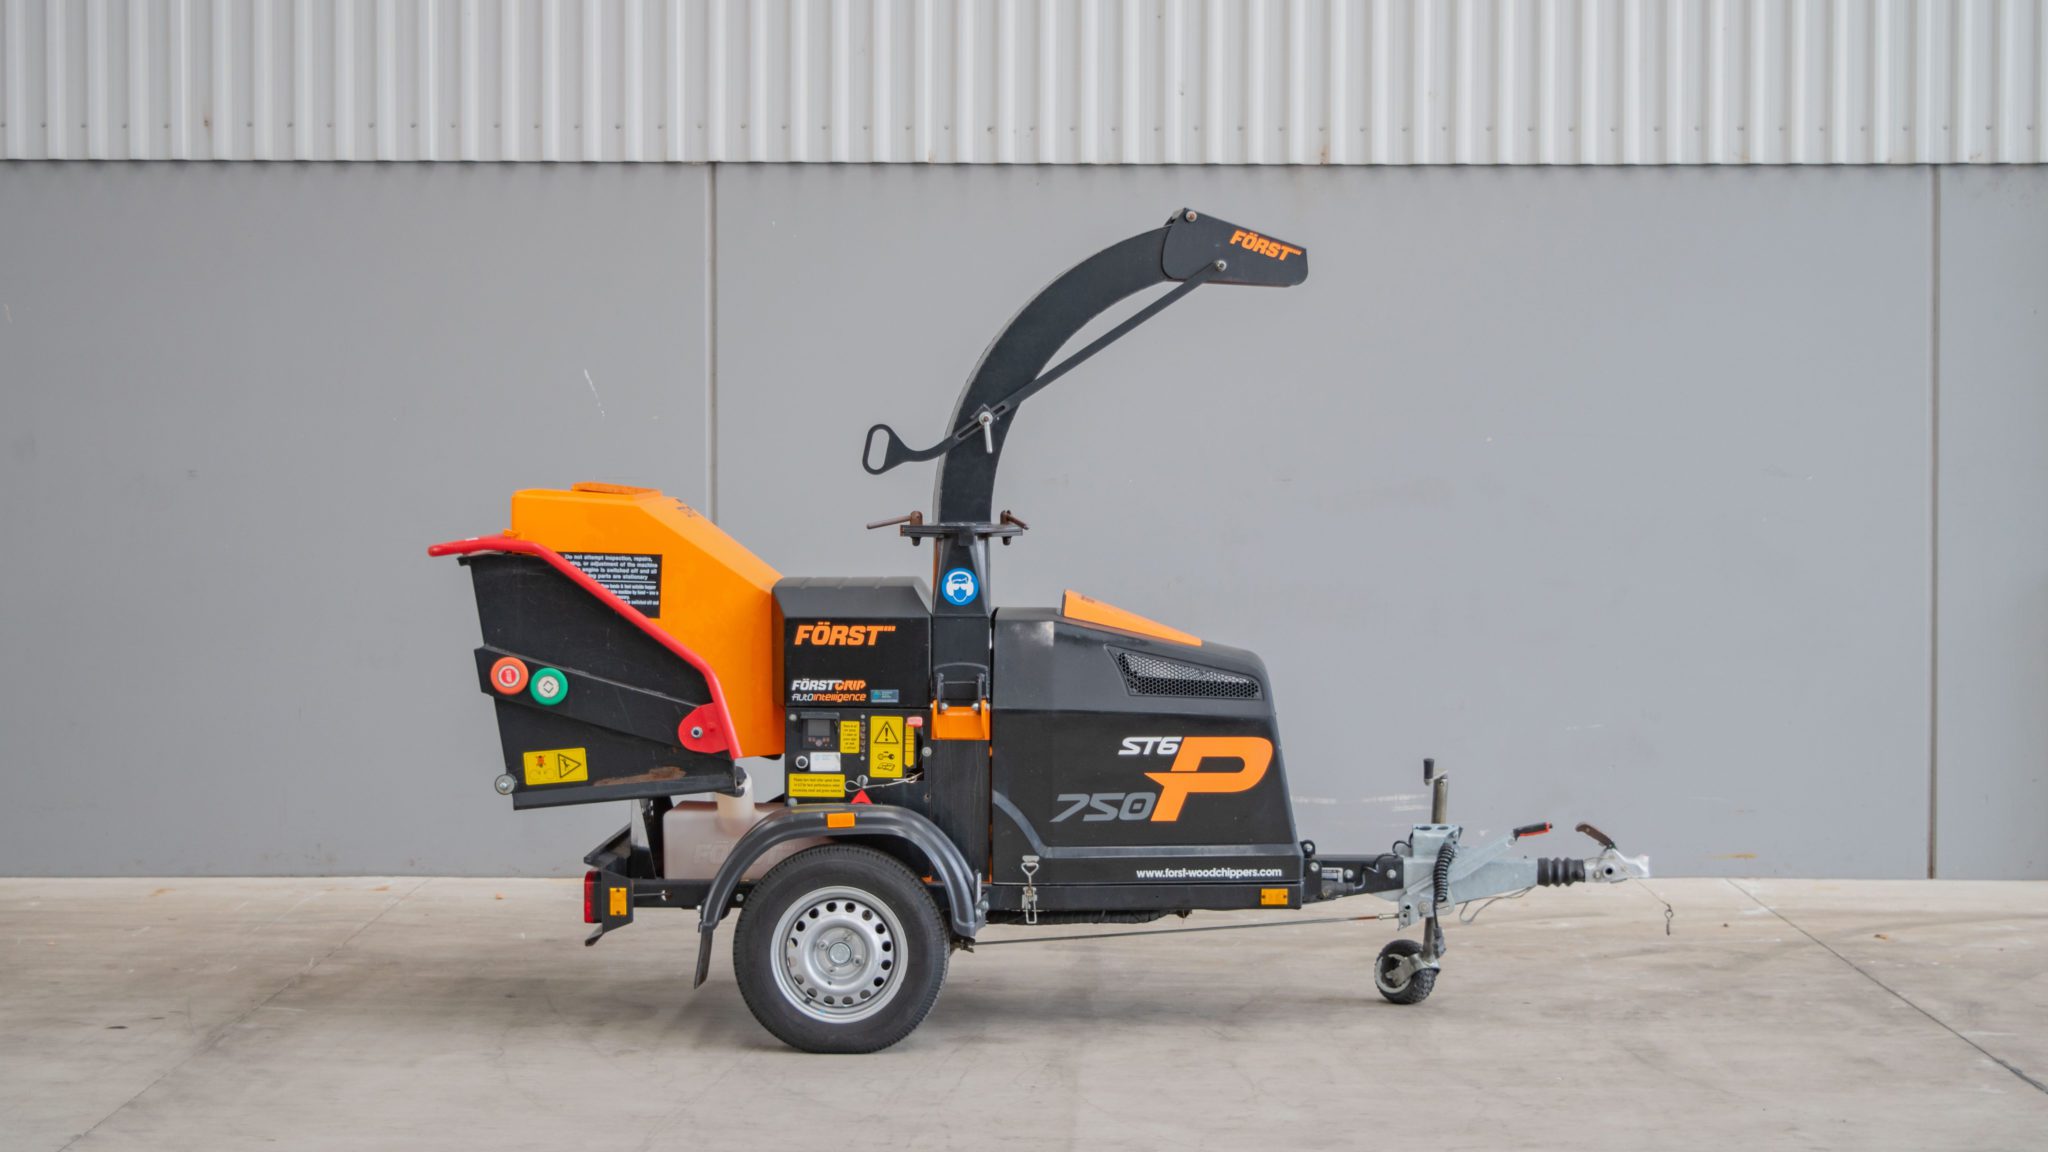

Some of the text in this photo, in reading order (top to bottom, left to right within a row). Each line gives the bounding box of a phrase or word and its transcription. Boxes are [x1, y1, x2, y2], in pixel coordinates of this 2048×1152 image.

[1229, 229, 1302, 261] FÖRST
[794, 621, 896, 646] FÖRST
[1118, 736, 1182, 756] ST6
[1049, 791, 1157, 823] 750
[1136, 867, 1282, 879] www.forst-woodchippers.com
